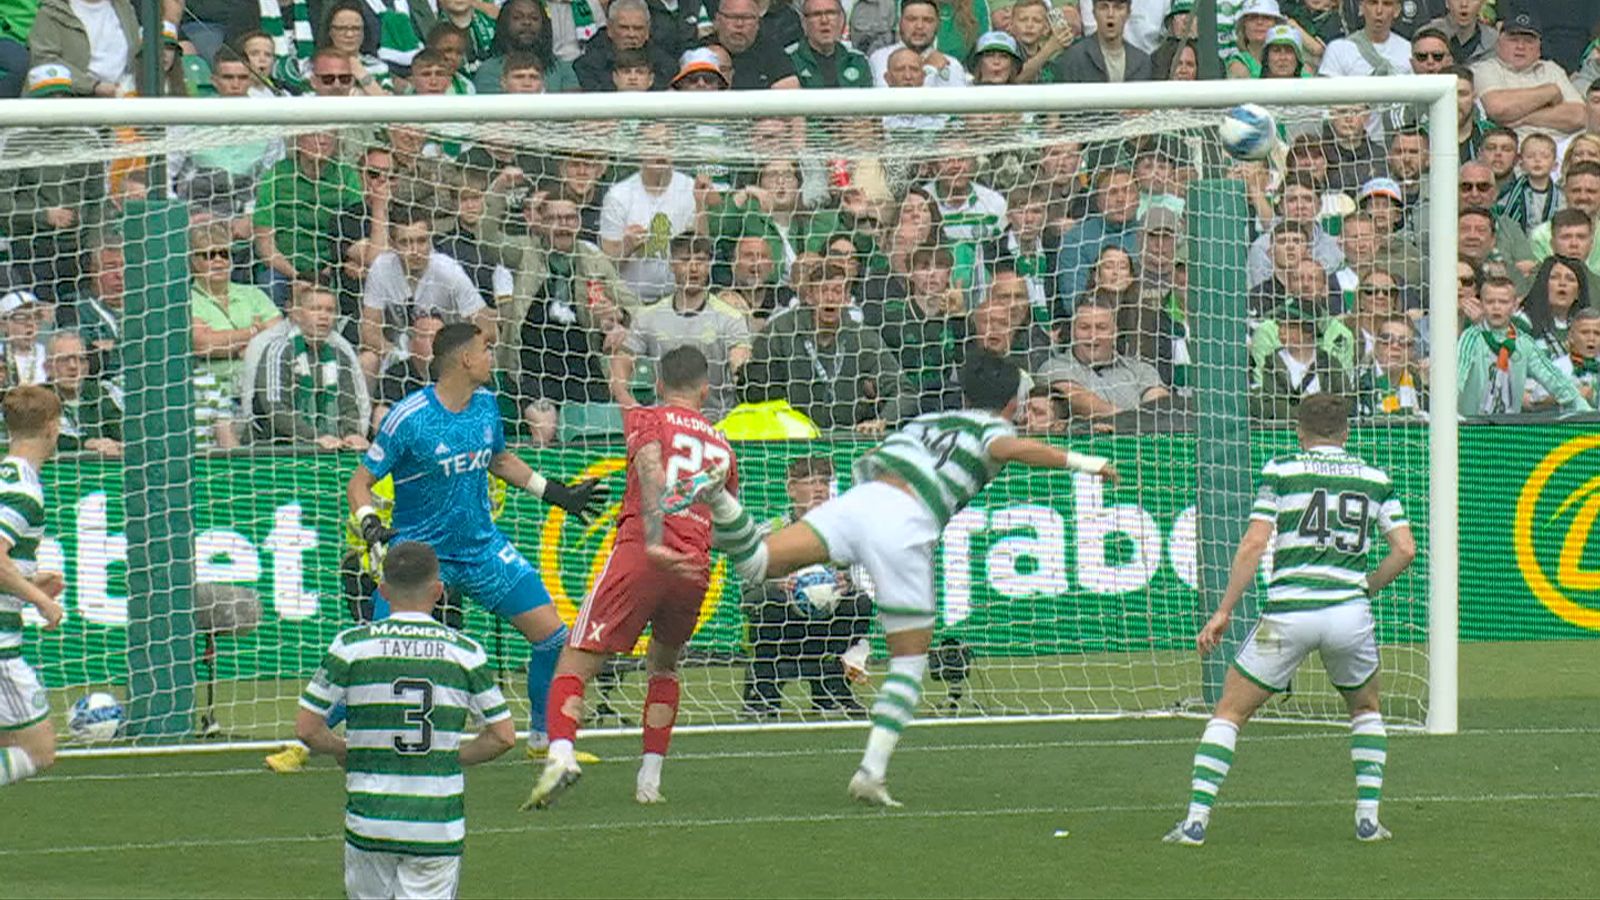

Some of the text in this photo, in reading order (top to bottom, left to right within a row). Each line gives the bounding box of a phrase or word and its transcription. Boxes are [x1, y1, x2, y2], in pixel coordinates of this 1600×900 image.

[438, 448, 492, 477] TEXO
[665, 432, 730, 490] 27
[1304, 461, 1363, 478] FORREST
[1298, 488, 1369, 555] 49
[369, 623, 458, 642] MAGNERS
[379, 639, 446, 658] TAYLOR
[392, 677, 434, 755] 3
